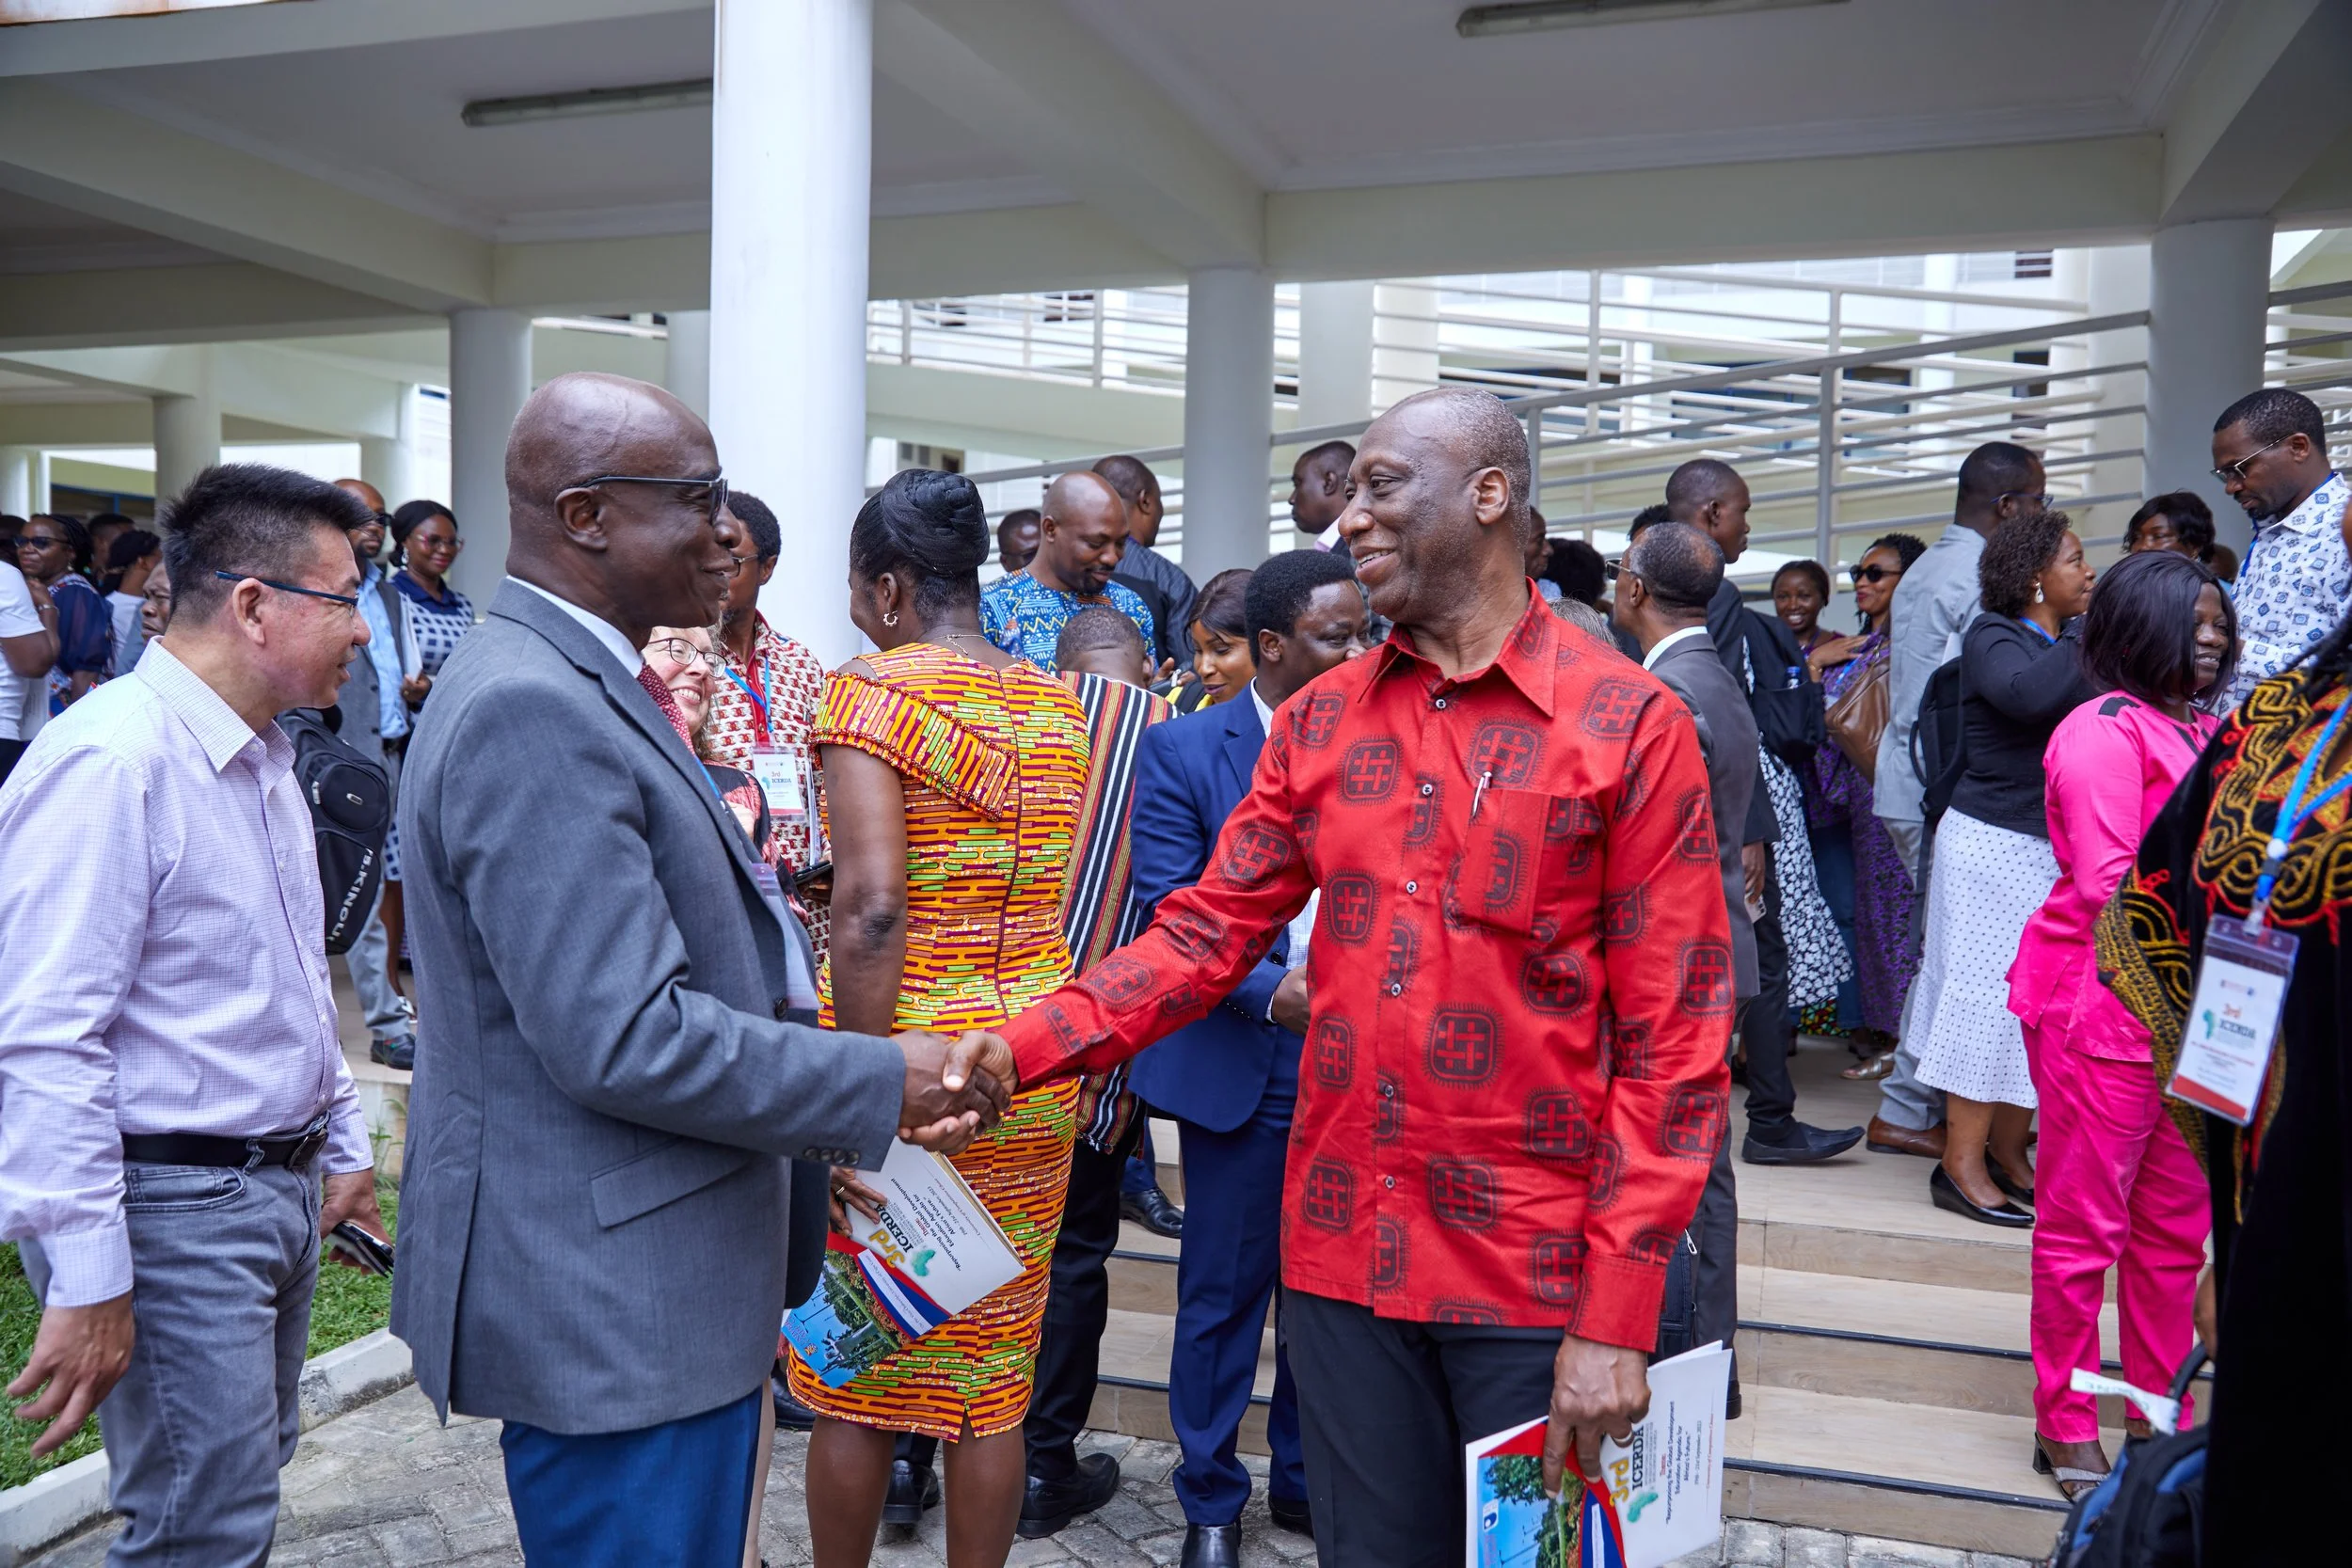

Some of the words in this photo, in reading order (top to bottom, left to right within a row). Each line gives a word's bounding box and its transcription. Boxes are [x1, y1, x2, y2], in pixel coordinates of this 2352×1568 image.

[890, 1177, 917, 1211] Development
[912, 1193, 920, 1202] for
[914, 1210, 930, 1228] Global
[918, 1200, 936, 1222] Agenda
[873, 1202, 914, 1253] ICERDA
[914, 1217, 929, 1236] Theme:
[928, 1227, 937, 1237] the
[933, 1221, 954, 1246] Education
[867, 1227, 904, 1268] 3rd
[1632, 1425, 1644, 1490] ICERDA
[1609, 1458, 1629, 1506] 3rd
